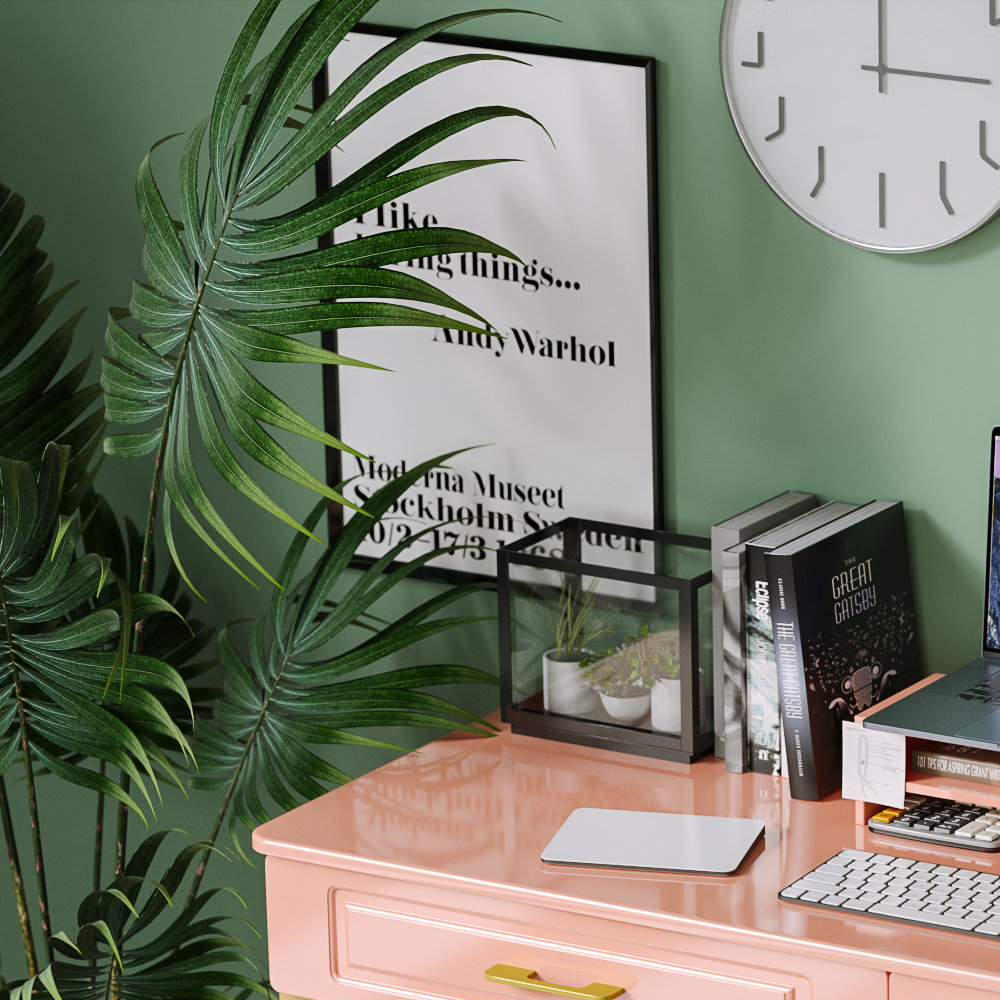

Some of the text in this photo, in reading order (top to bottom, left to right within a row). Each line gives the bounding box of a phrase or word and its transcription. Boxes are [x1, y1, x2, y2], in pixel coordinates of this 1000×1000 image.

[376, 201, 438, 230] like
[510, 327, 616, 367] Warhol
[355, 455, 565, 509] Modrna Museet
[355, 484, 643, 553] Sockholm Swden
[831, 558, 872, 600] GREAT
[752, 580, 770, 621] Eclipse
[834, 584, 877, 625] GATSBY
[776, 621, 796, 641] THE
[782, 679, 803, 720] GATSBY
[917, 755, 926, 768] 101
[927, 757, 937, 770] TIPS
[937, 759, 948, 772] FOR
[947, 761, 971, 776] ASPIRING
[971, 764, 989, 779] GRANT
